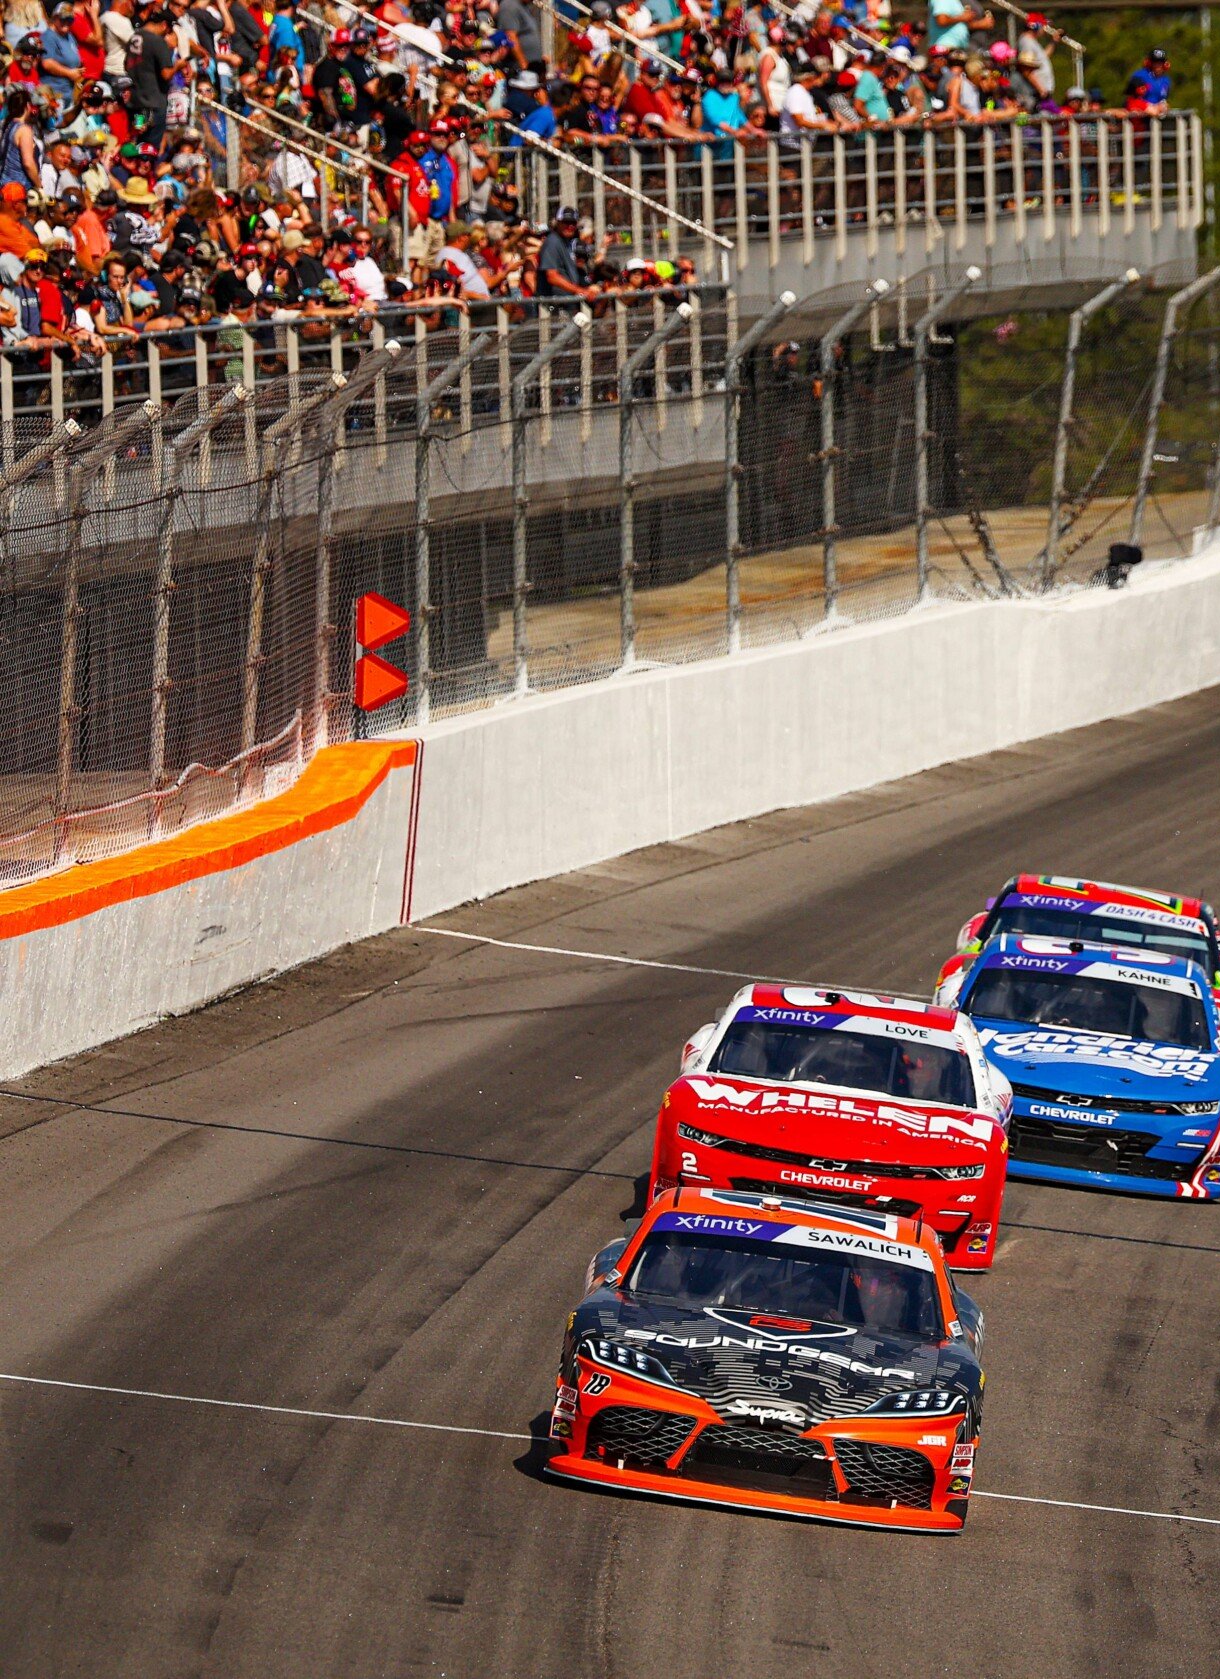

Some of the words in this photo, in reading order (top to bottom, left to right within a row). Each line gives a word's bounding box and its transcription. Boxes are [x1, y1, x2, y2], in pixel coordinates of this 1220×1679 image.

[1020, 894, 1085, 911] xfinity
[1105, 905, 1145, 919] DASH
[1147, 911, 1156, 920] 4
[1158, 914, 1198, 929] CASH
[1001, 955, 1069, 974] xfinity
[1118, 969, 1171, 986] KAHNE
[753, 1007, 826, 1025] xfinity
[886, 1024, 928, 1038] LOVE
[685, 1079, 995, 1142] WHELEN
[1030, 1104, 1116, 1125] CHEVROLET
[697, 1102, 867, 1122] MANUFACTURED
[872, 1118, 893, 1128] IN
[896, 1128, 988, 1151] AMERICA
[681, 1152, 698, 1173] 2
[780, 1170, 872, 1191] CHEVROLET
[675, 1214, 763, 1235] xfinity
[808, 1231, 912, 1259] SAWALICH
[624, 1329, 916, 1379] SOUNDGEAR
[581, 1372, 611, 1397] 18
[727, 1399, 806, 1425] Supra
